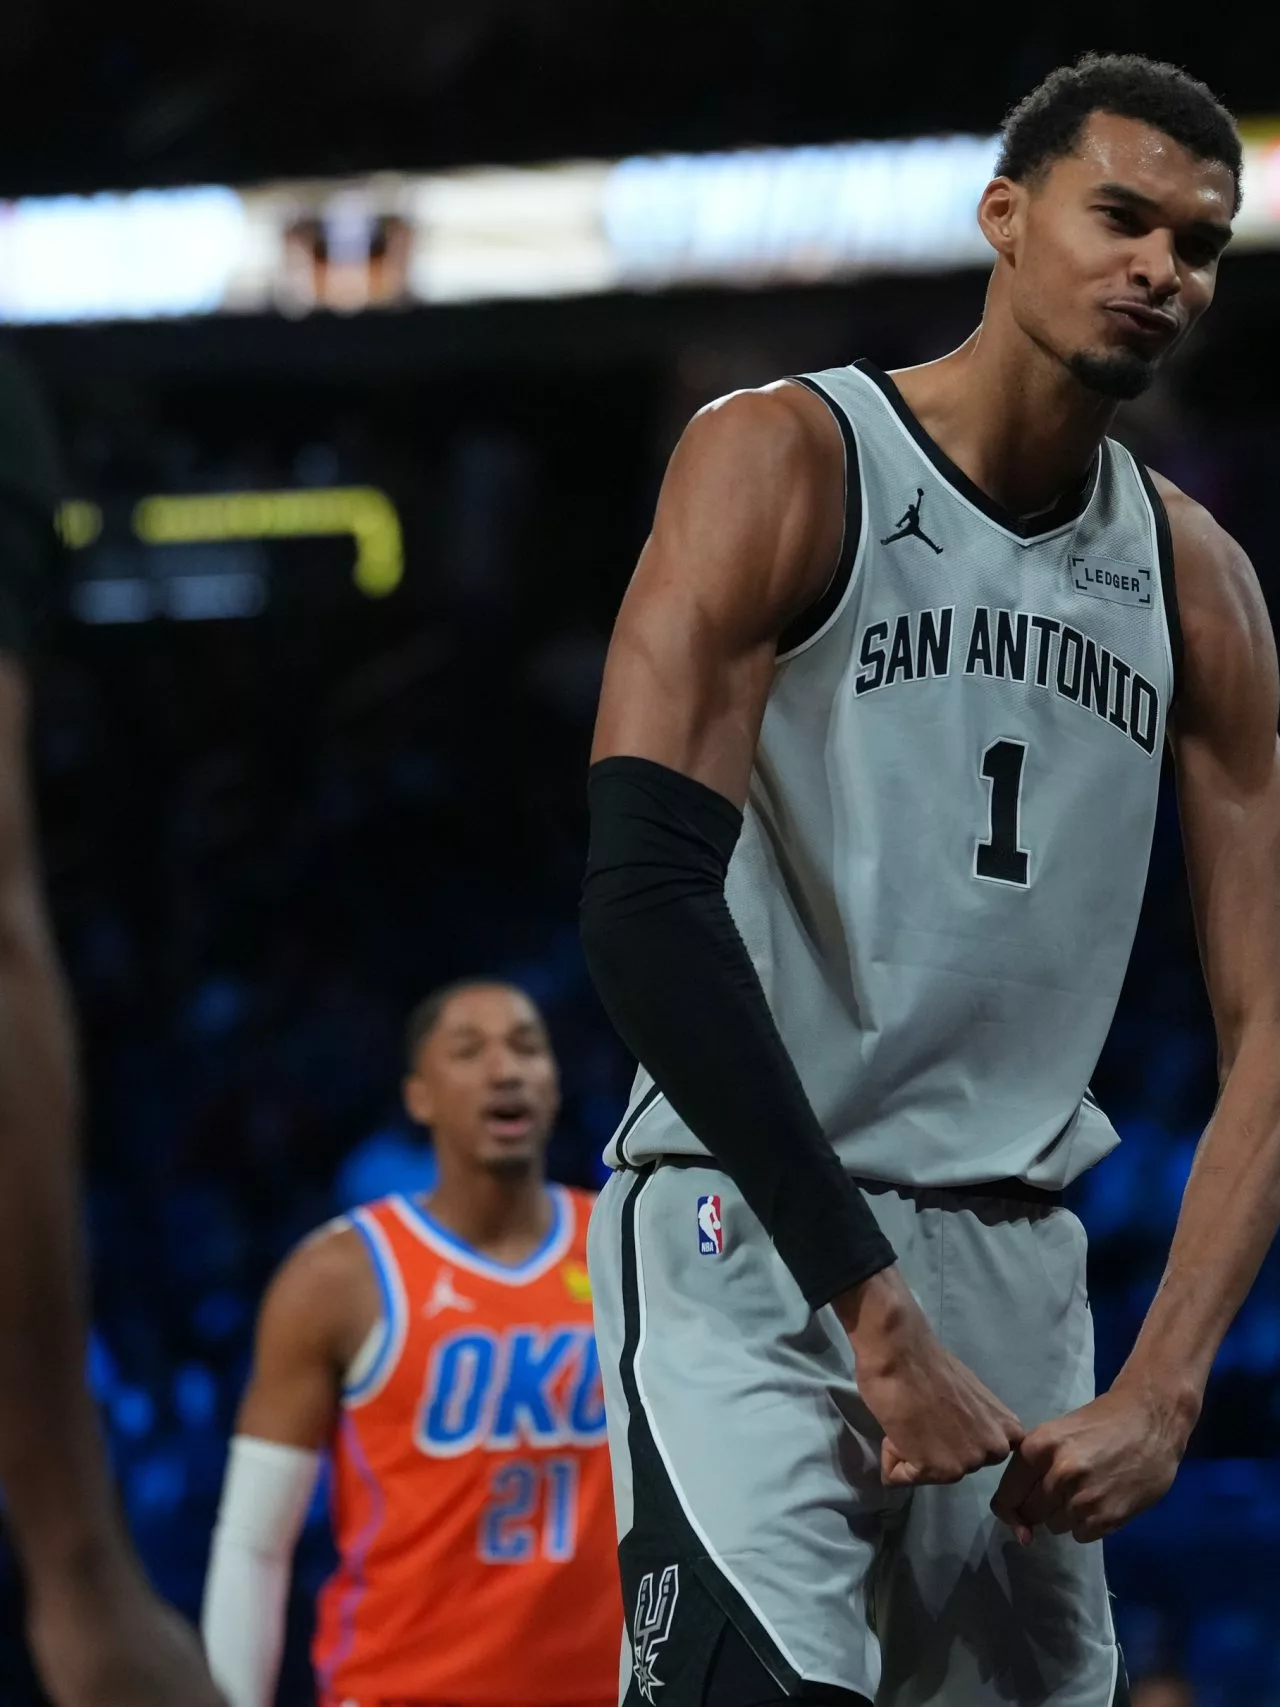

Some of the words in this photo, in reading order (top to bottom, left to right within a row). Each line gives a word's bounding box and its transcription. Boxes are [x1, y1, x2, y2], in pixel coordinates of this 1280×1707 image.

[1084, 567, 1140, 593] LEDGER
[854, 605, 956, 698] SAN
[962, 606, 1160, 759] ANTONIO
[972, 736, 1031, 889] 1
[701, 1241, 715, 1253] NBA
[478, 1458, 579, 1566] 21
